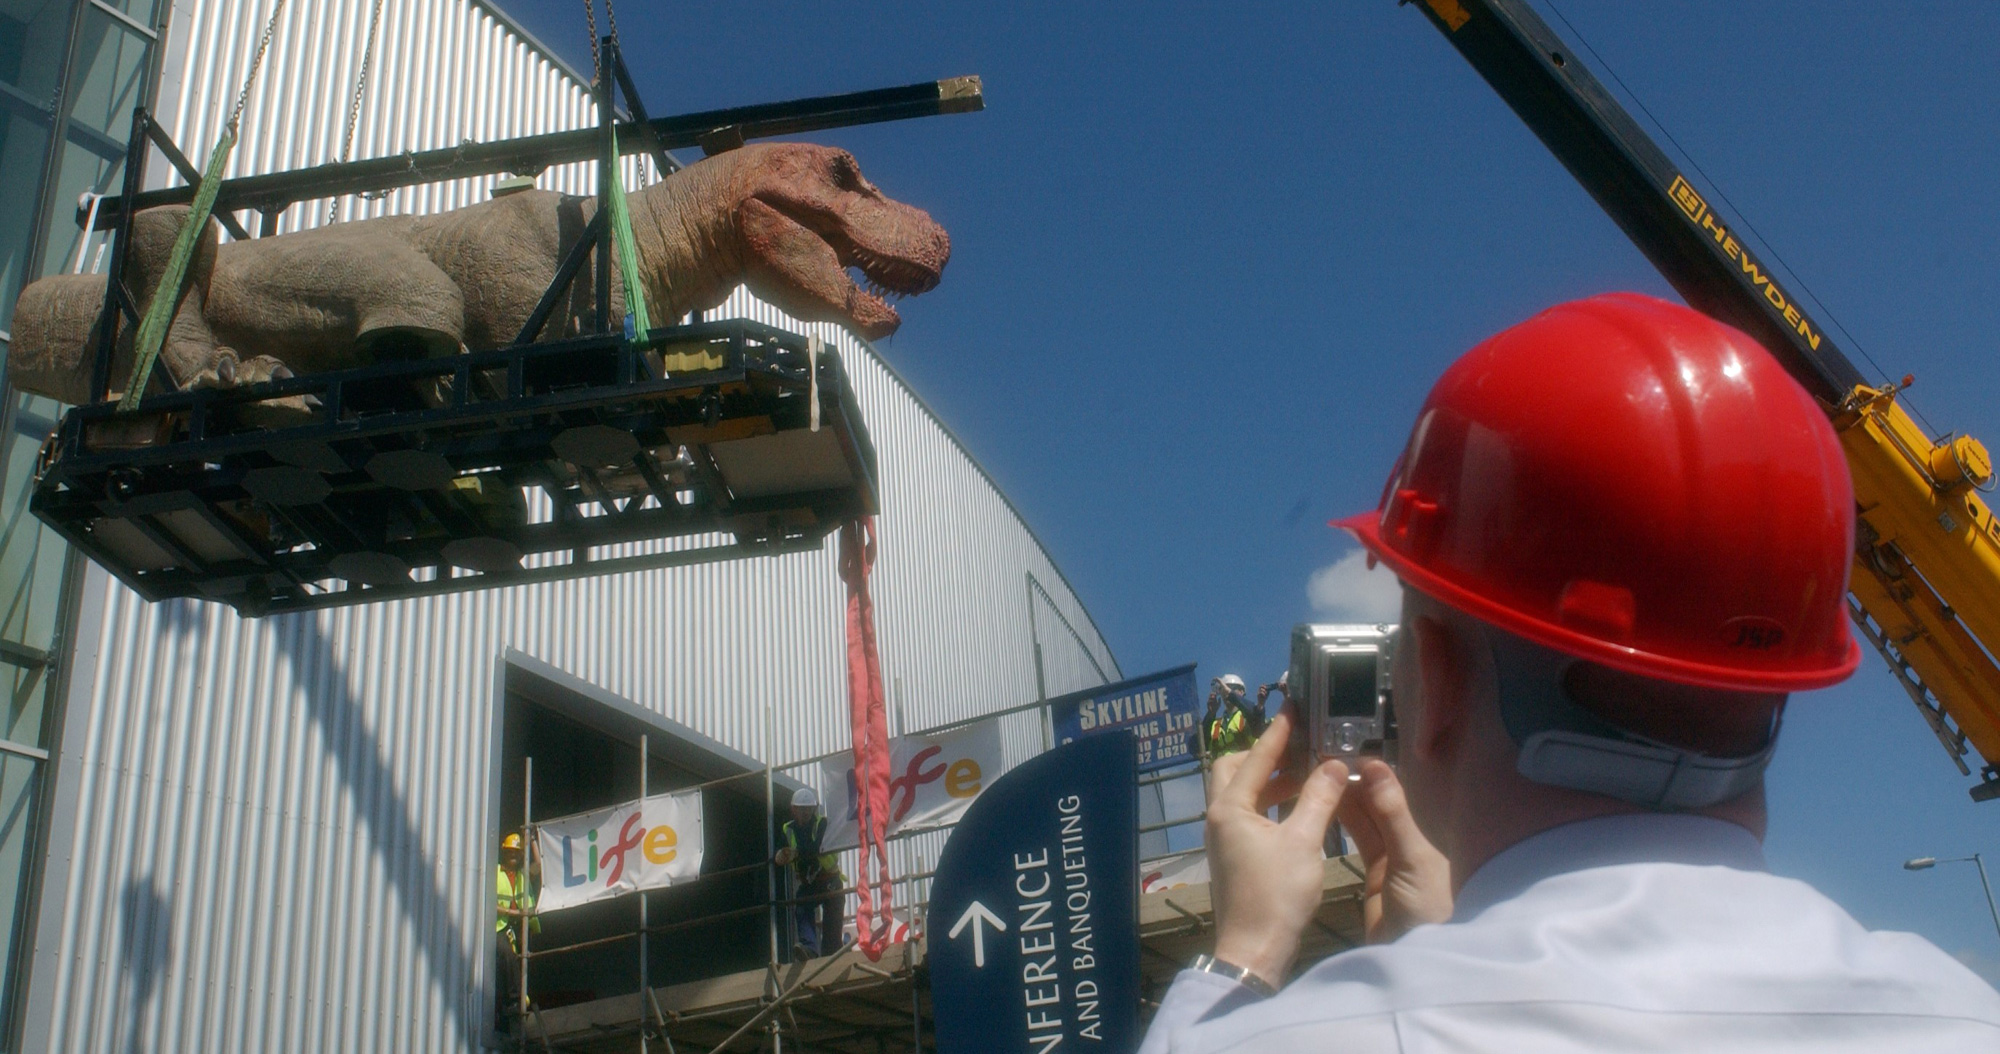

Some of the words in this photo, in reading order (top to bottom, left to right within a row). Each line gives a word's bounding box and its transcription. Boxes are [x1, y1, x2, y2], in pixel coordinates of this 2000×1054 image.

[1702, 213, 1821, 351] HEWDEN
[1079, 687, 1168, 730] SKYLINE
[846, 745, 982, 819] Lfe
[562, 811, 678, 888] Life
[1057, 795, 1096, 970] BANQUETING
[1075, 980, 1103, 1040] AND
